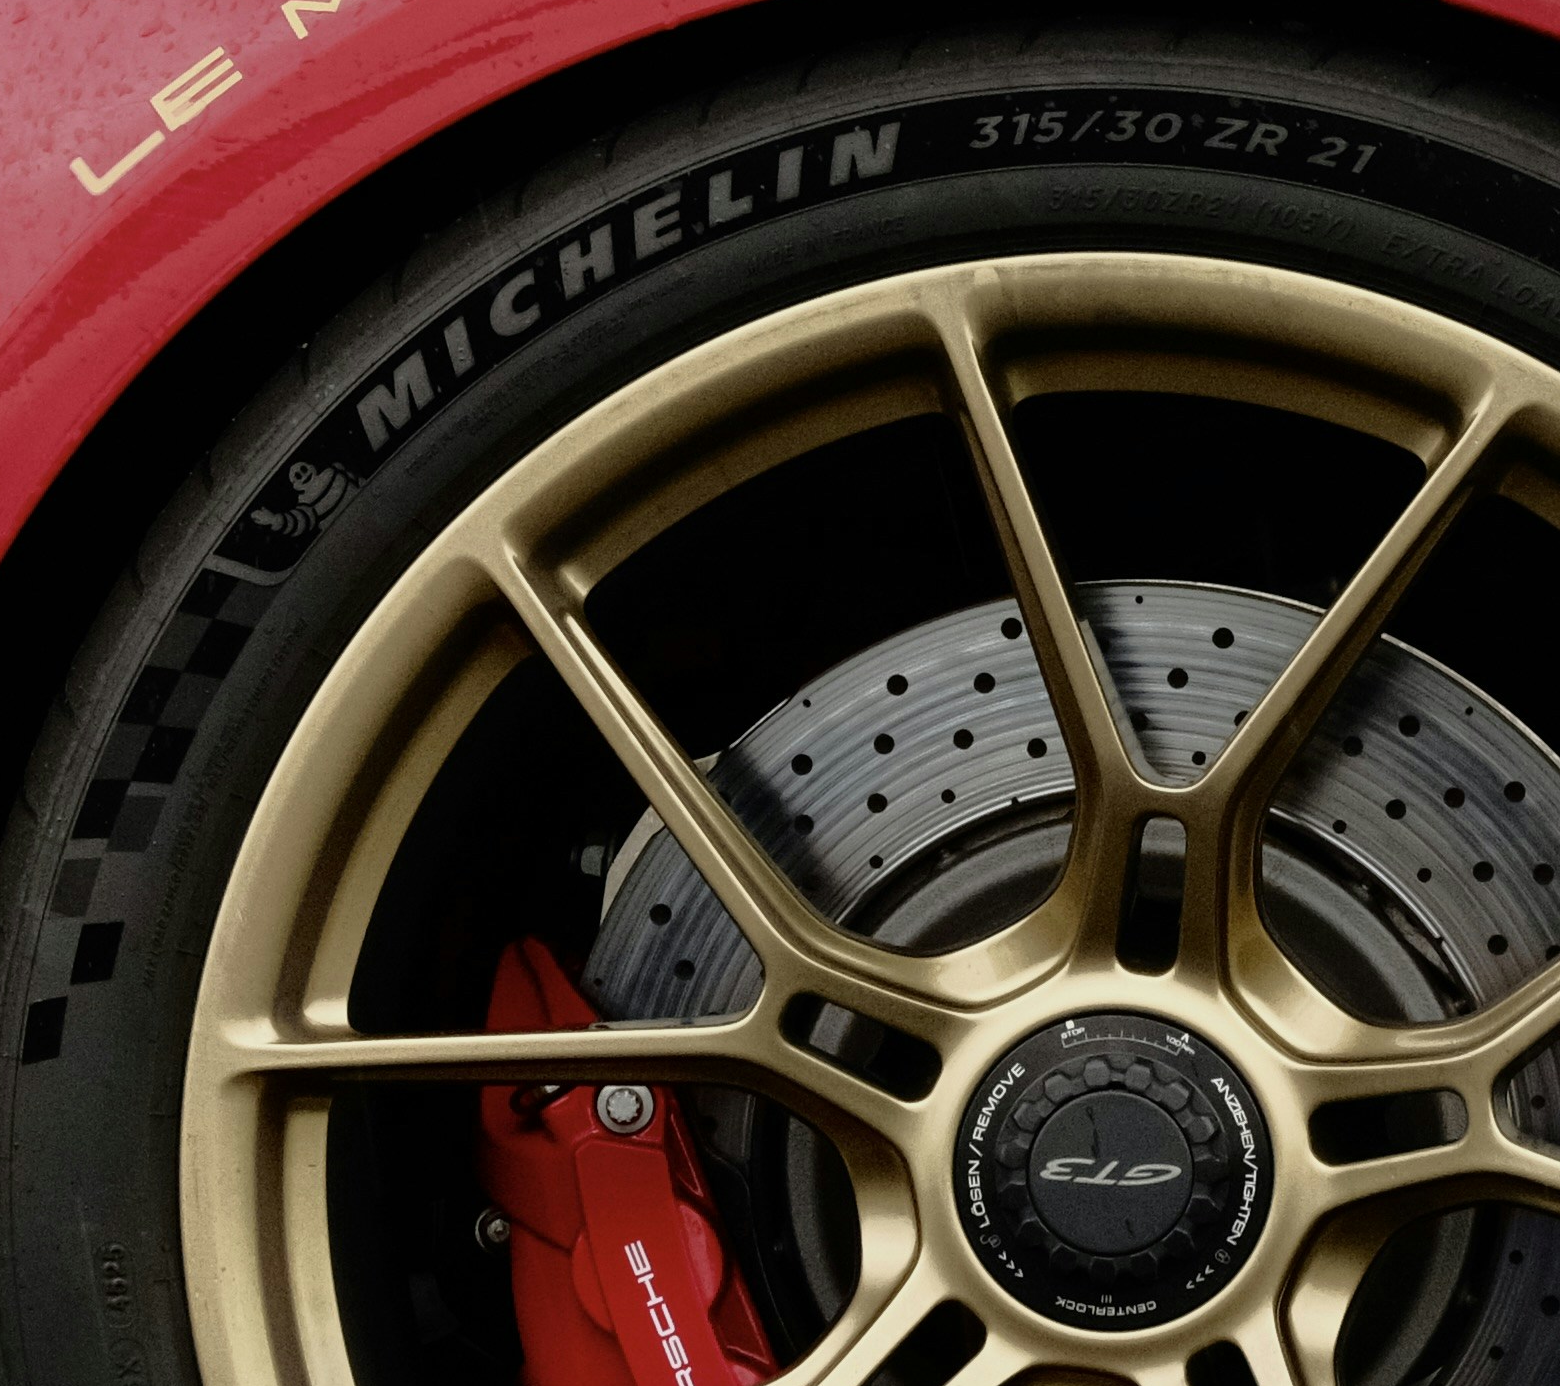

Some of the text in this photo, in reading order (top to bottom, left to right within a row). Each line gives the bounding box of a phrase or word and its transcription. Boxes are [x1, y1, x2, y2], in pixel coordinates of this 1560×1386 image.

[70, 46, 242, 195] LE
[964, 107, 1379, 179] 315/30 ZR 21
[356, 120, 903, 455] MICHELIN
[1376, 226, 1489, 288] EXTRA
[972, 1062, 1027, 1142] REMOVE
[1039, 1157, 1182, 1186] GT3
[1210, 1076, 1259, 1246] ANZIEHEN/TIGHTEN
[1055, 1295, 1157, 1316] CENTERLOCK
